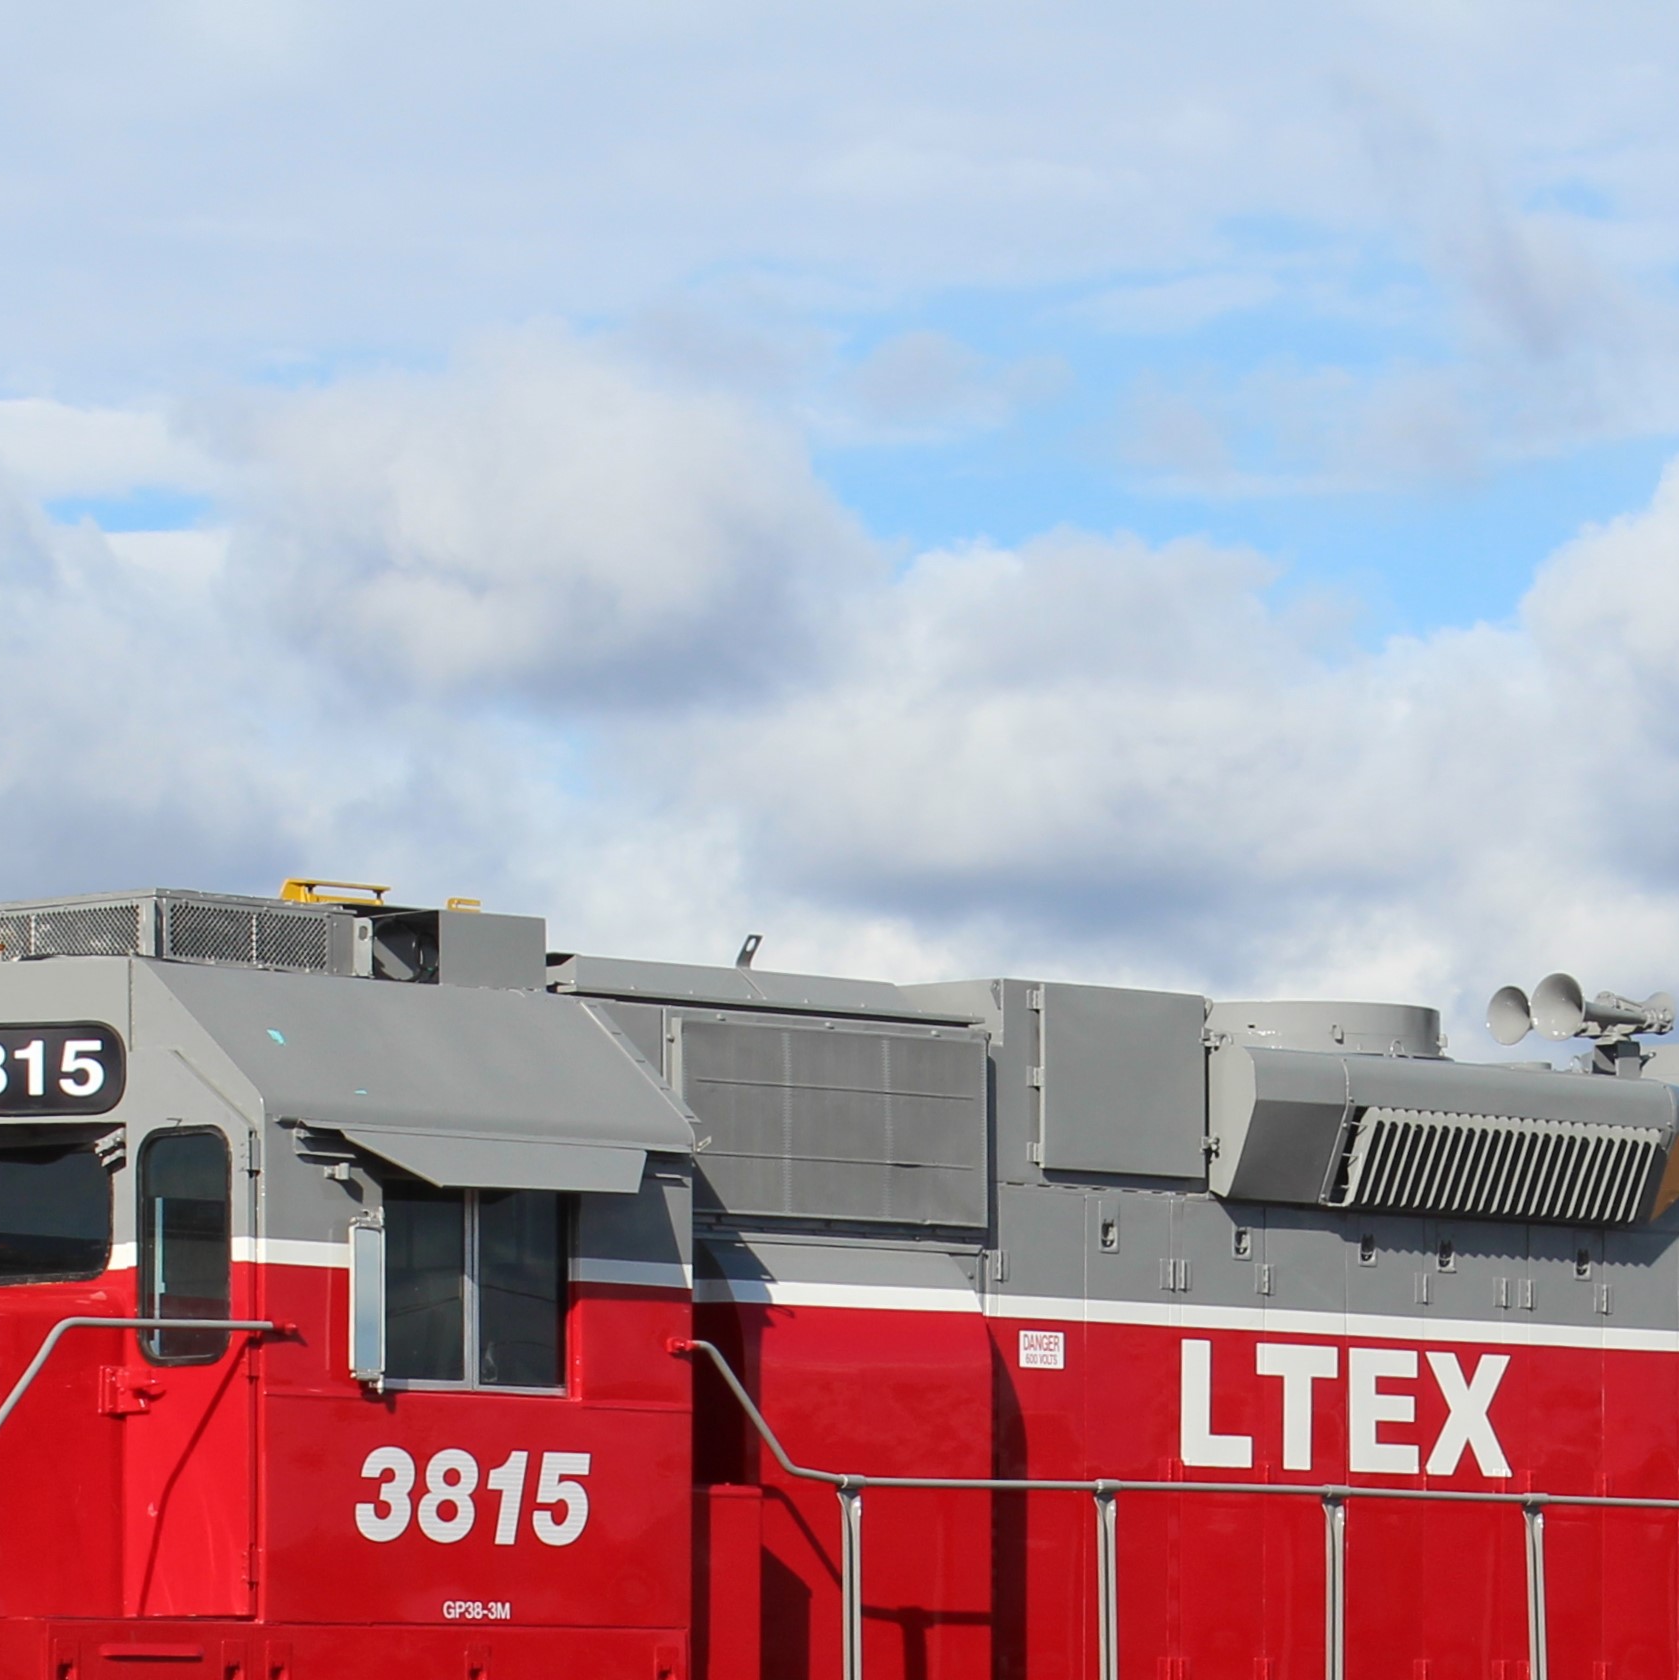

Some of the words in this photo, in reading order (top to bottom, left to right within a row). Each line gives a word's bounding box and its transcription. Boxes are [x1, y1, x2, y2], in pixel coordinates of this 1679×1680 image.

[1023, 1333, 1060, 1352] DANGER
[1025, 1353, 1038, 1364] 600
[1039, 1354, 1058, 1366] VOLTS
[1180, 1338, 1514, 1478] LTEX
[354, 1445, 592, 1547] 3815
[443, 1601, 511, 1620] GP38-3M
